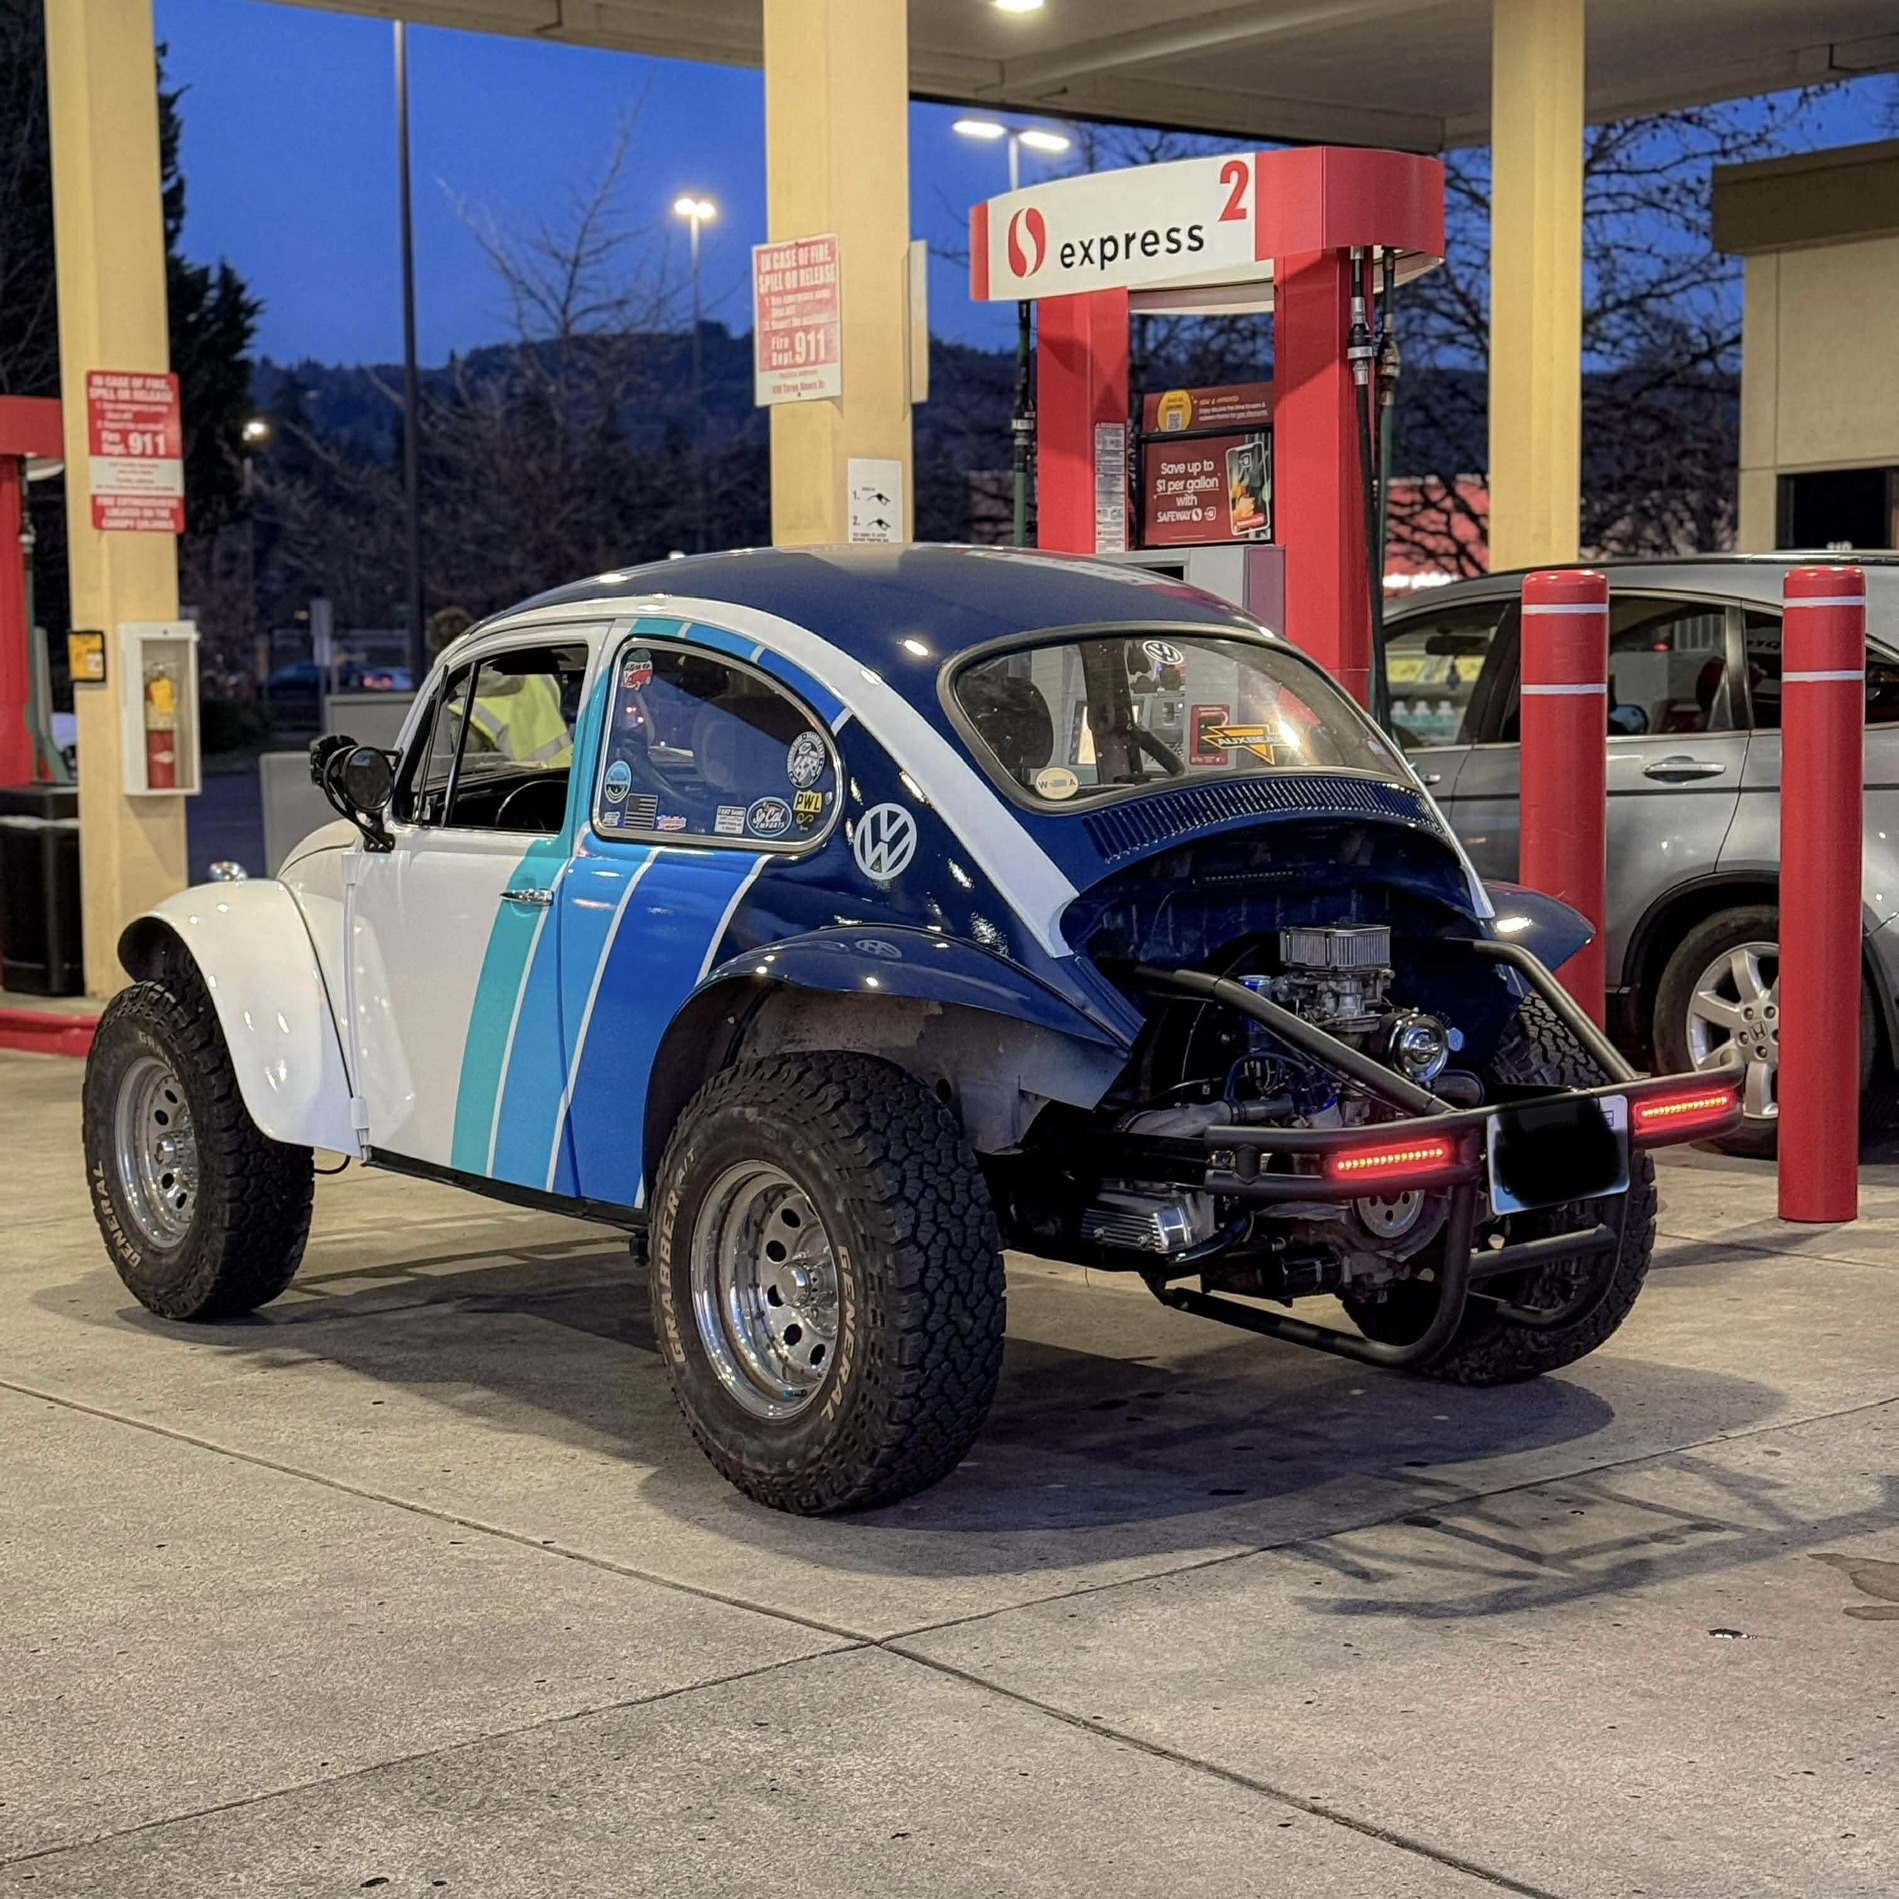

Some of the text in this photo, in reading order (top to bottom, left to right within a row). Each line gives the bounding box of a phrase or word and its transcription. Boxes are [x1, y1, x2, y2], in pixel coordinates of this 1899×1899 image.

[1219, 160, 1249, 222] 2
[773, 247, 797, 270] CASE
[798, 245, 810, 266] OF
[1060, 224, 1205, 271] express
[759, 263, 837, 295] SPILL OR RELEASE
[772, 331, 789, 350] Fire
[795, 328, 826, 364] 911
[128, 431, 166, 455] 911
[1161, 459, 1215, 476] Save up to
[1156, 475, 1219, 495] $1 per gallon
[1176, 494, 1198, 507] with
[852, 515, 861, 526] 2.
[1157, 510, 1191, 523] SAFEWAY
[1142, 640, 1184, 665] VW
[1038, 778, 1077, 789] W A
[795, 793, 821, 811] PWL
[755, 821, 785, 830] IMPORTS
[765, 806, 785, 823] Cal
[854, 803, 918, 880] VW
[92, 1160, 142, 1269] GENERAL
[660, 1189, 688, 1364] GRABBER
[820, 1244, 857, 1422] GENERAL
